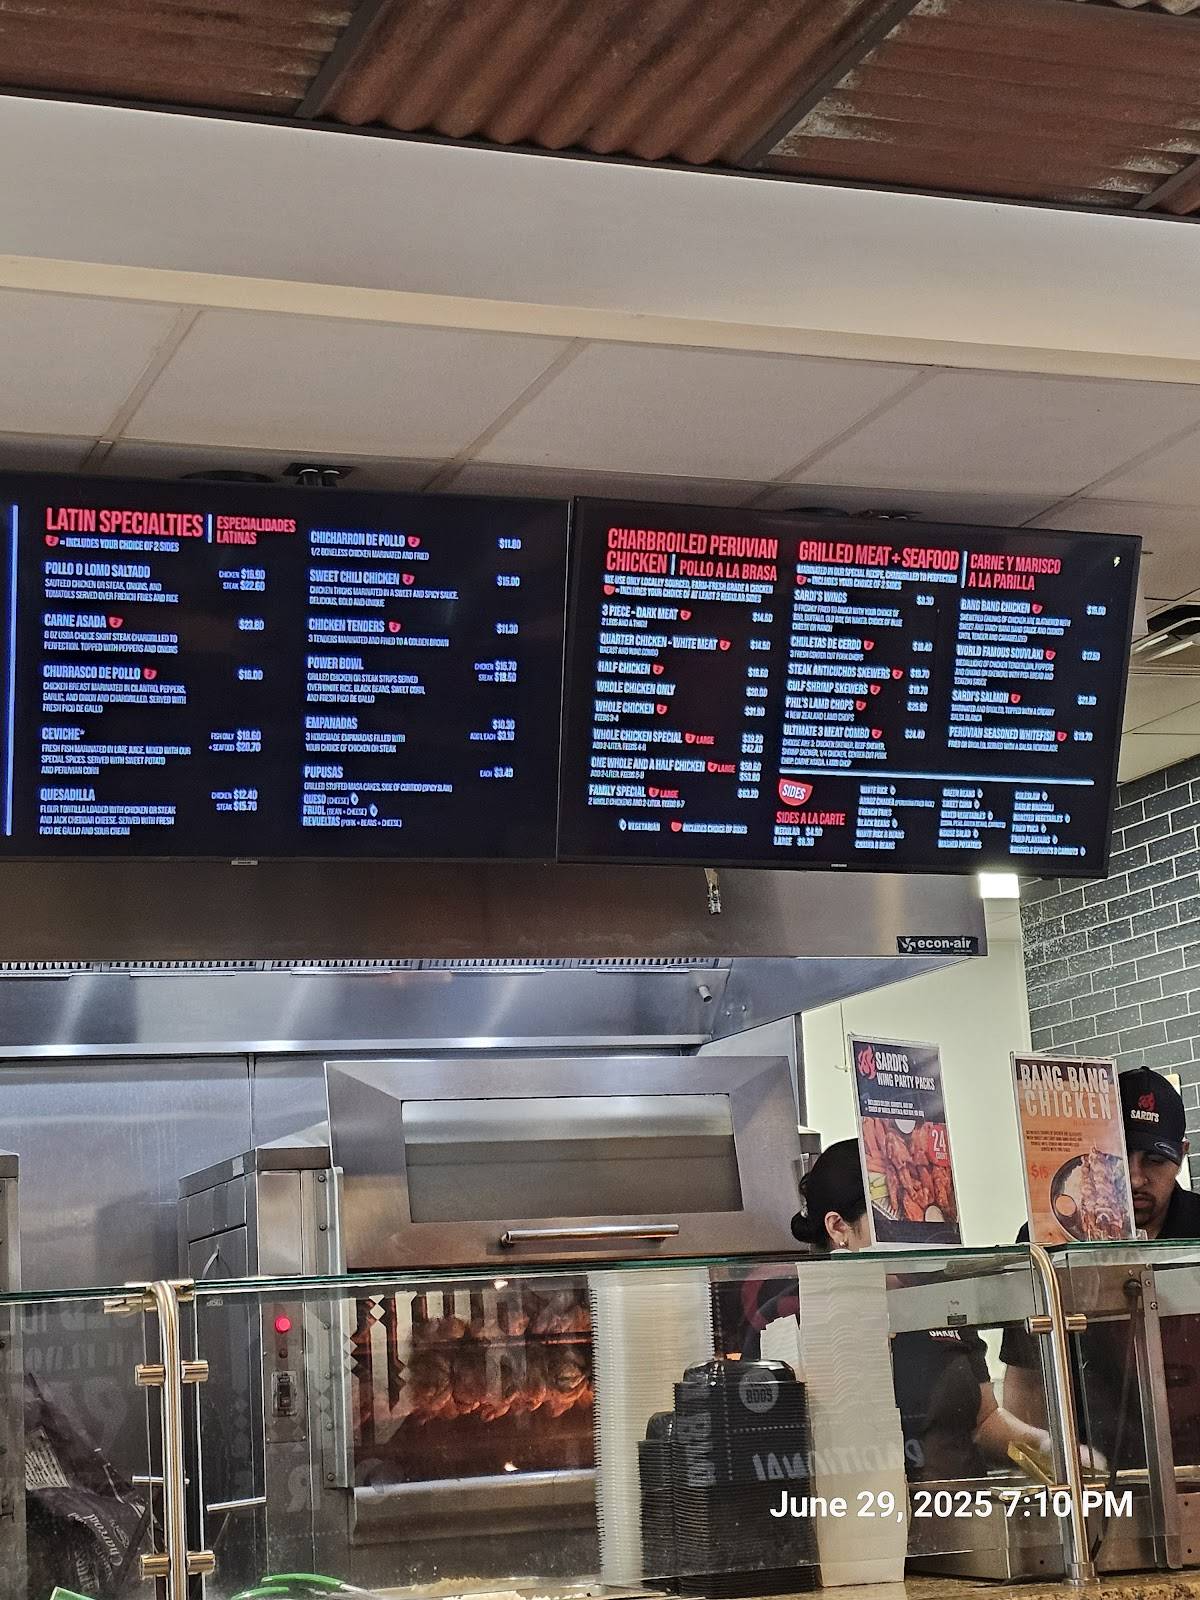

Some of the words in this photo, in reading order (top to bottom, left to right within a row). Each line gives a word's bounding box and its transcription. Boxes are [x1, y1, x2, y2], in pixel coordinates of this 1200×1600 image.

[46, 507, 96, 532] LATIN
[100, 510, 203, 537] SPECIALTIES
[217, 516, 296, 533] ESPECIALIDADES
[66, 537, 99, 548] INCLUDES
[100, 539, 119, 550] YOUR
[120, 540, 143, 550] CHOICE
[144, 541, 153, 551] OF
[160, 542, 179, 552] SIDES
[217, 530, 257, 544] LATINAS
[311, 531, 365, 545] CHICHARRON
[366, 534, 377, 546] DE
[378, 534, 405, 547] POLLO
[608, 528, 707, 554] CHARBROILED
[710, 535, 778, 559] PERUVIAN
[800, 541, 853, 563] GRILLED
[855, 545, 892, 566] MEAT
[902, 548, 959, 570] SEAFOOD
[45, 562, 74, 575] POLLO
[84, 563, 110, 577] LOMO
[111, 565, 150, 578] SALTADO
[606, 551, 667, 574] CHICKEN
[680, 560, 713, 577] POLLO
[715, 562, 723, 578] A
[726, 562, 740, 579] LA
[742, 564, 777, 581] BRASA
[970, 553, 1004, 571] CARNE
[1007, 556, 1014, 571] Y
[1015, 557, 1061, 574] MARISCO
[310, 569, 339, 582] SWEET
[340, 571, 362, 583] CHILI
[363, 571, 399, 585] CHICKEN
[968, 572, 976, 587] A
[979, 573, 991, 587] LA
[993, 574, 1035, 590] PARILLA
[824, 591, 847, 603] WINGS
[609, 606, 630, 617] PIECE
[636, 607, 656, 619] DARK
[658, 609, 678, 620] MEAT
[961, 598, 980, 610] BANG
[981, 600, 1000, 612] BANG
[1001, 601, 1030, 613] CHICKEN
[45, 614, 75, 627] CARNE
[76, 615, 106, 628] ASADA
[309, 618, 345, 631] CHICKEN
[347, 619, 384, 633] TENDERS
[600, 633, 634, 645] QUARTER
[635, 635, 667, 647] CHICKEN
[673, 638, 696, 649] WHITE
[697, 639, 718, 650] MEAT
[791, 636, 827, 648] CHULETAS
[828, 638, 837, 649] DE
[838, 639, 861, 650] CERDO
[956, 644, 981, 657] WORLD
[982, 646, 1009, 658] FAMOUS
[308, 656, 338, 669] POWER
[339, 657, 363, 669] BOWL
[598, 661, 617, 673] HALF
[619, 663, 650, 675] CHICKEN
[43, 665, 97, 679] CHURRASCO
[98, 667, 111, 679] DE
[112, 668, 141, 680] POLLO
[788, 663, 811, 675] STEAK
[857, 667, 890, 679] SKEWERS
[596, 681, 623, 693] WHOLE
[624, 682, 655, 694] CHICKEN
[656, 684, 675, 696] ONLY
[787, 680, 806, 691] GULF
[807, 681, 833, 693] SHRIMP
[834, 682, 868, 694] SKEWERS
[809, 698, 829, 709] LAMB
[830, 699, 853, 710] CHOPS
[980, 691, 1009, 703] SALMON
[595, 701, 621, 713] WHOLE
[622, 702, 654, 714] CHICKEN
[306, 717, 357, 729] EMPANADAS
[593, 728, 619, 740] WHOLE
[620, 729, 652, 742] CHICKEN
[653, 731, 682, 744] SPECIAL
[696, 736, 714, 745] LARGE
[784, 724, 818, 736] ULTIMATE
[824, 726, 843, 738] MEAT
[844, 727, 869, 738] COMBO
[949, 726, 983, 738] PERUVIAN
[984, 728, 1018, 740] SEASONED
[1019, 729, 1055, 741] WHITEFISH
[305, 766, 343, 778] PUPUSAS
[591, 757, 606, 768] ONE
[607, 758, 632, 769] WHOLE
[633, 758, 648, 769] AND
[656, 759, 673, 771] HALF
[675, 761, 705, 772] CHICKEN
[718, 765, 736, 773] LARGE
[40, 788, 95, 801] QUESADILLA
[589, 784, 616, 796] FAMILY
[617, 786, 646, 797] SPECIAL
[660, 790, 678, 798] LARGE
[782, 784, 806, 800] SIDES
[304, 794, 326, 804] QUESO
[303, 817, 340, 827] REVUELTAS
[776, 811, 799, 823] SIDES
[801, 812, 806, 824] A
[808, 813, 818, 824] LA
[820, 813, 845, 825] CARTE
[918, 938, 971, 948] econ-air
[875, 1052, 909, 1073] SARDI'S
[877, 1072, 894, 1087] WING
[894, 1074, 915, 1089] PARTY
[915, 1077, 935, 1090] PACKS
[1020, 1064, 1064, 1092] BANG
[1067, 1067, 1109, 1093] BANG
[1024, 1090, 1112, 1120] CHICKEN
[1130, 1109, 1160, 1123] SARDI'S
[932, 1130, 946, 1152] 24
